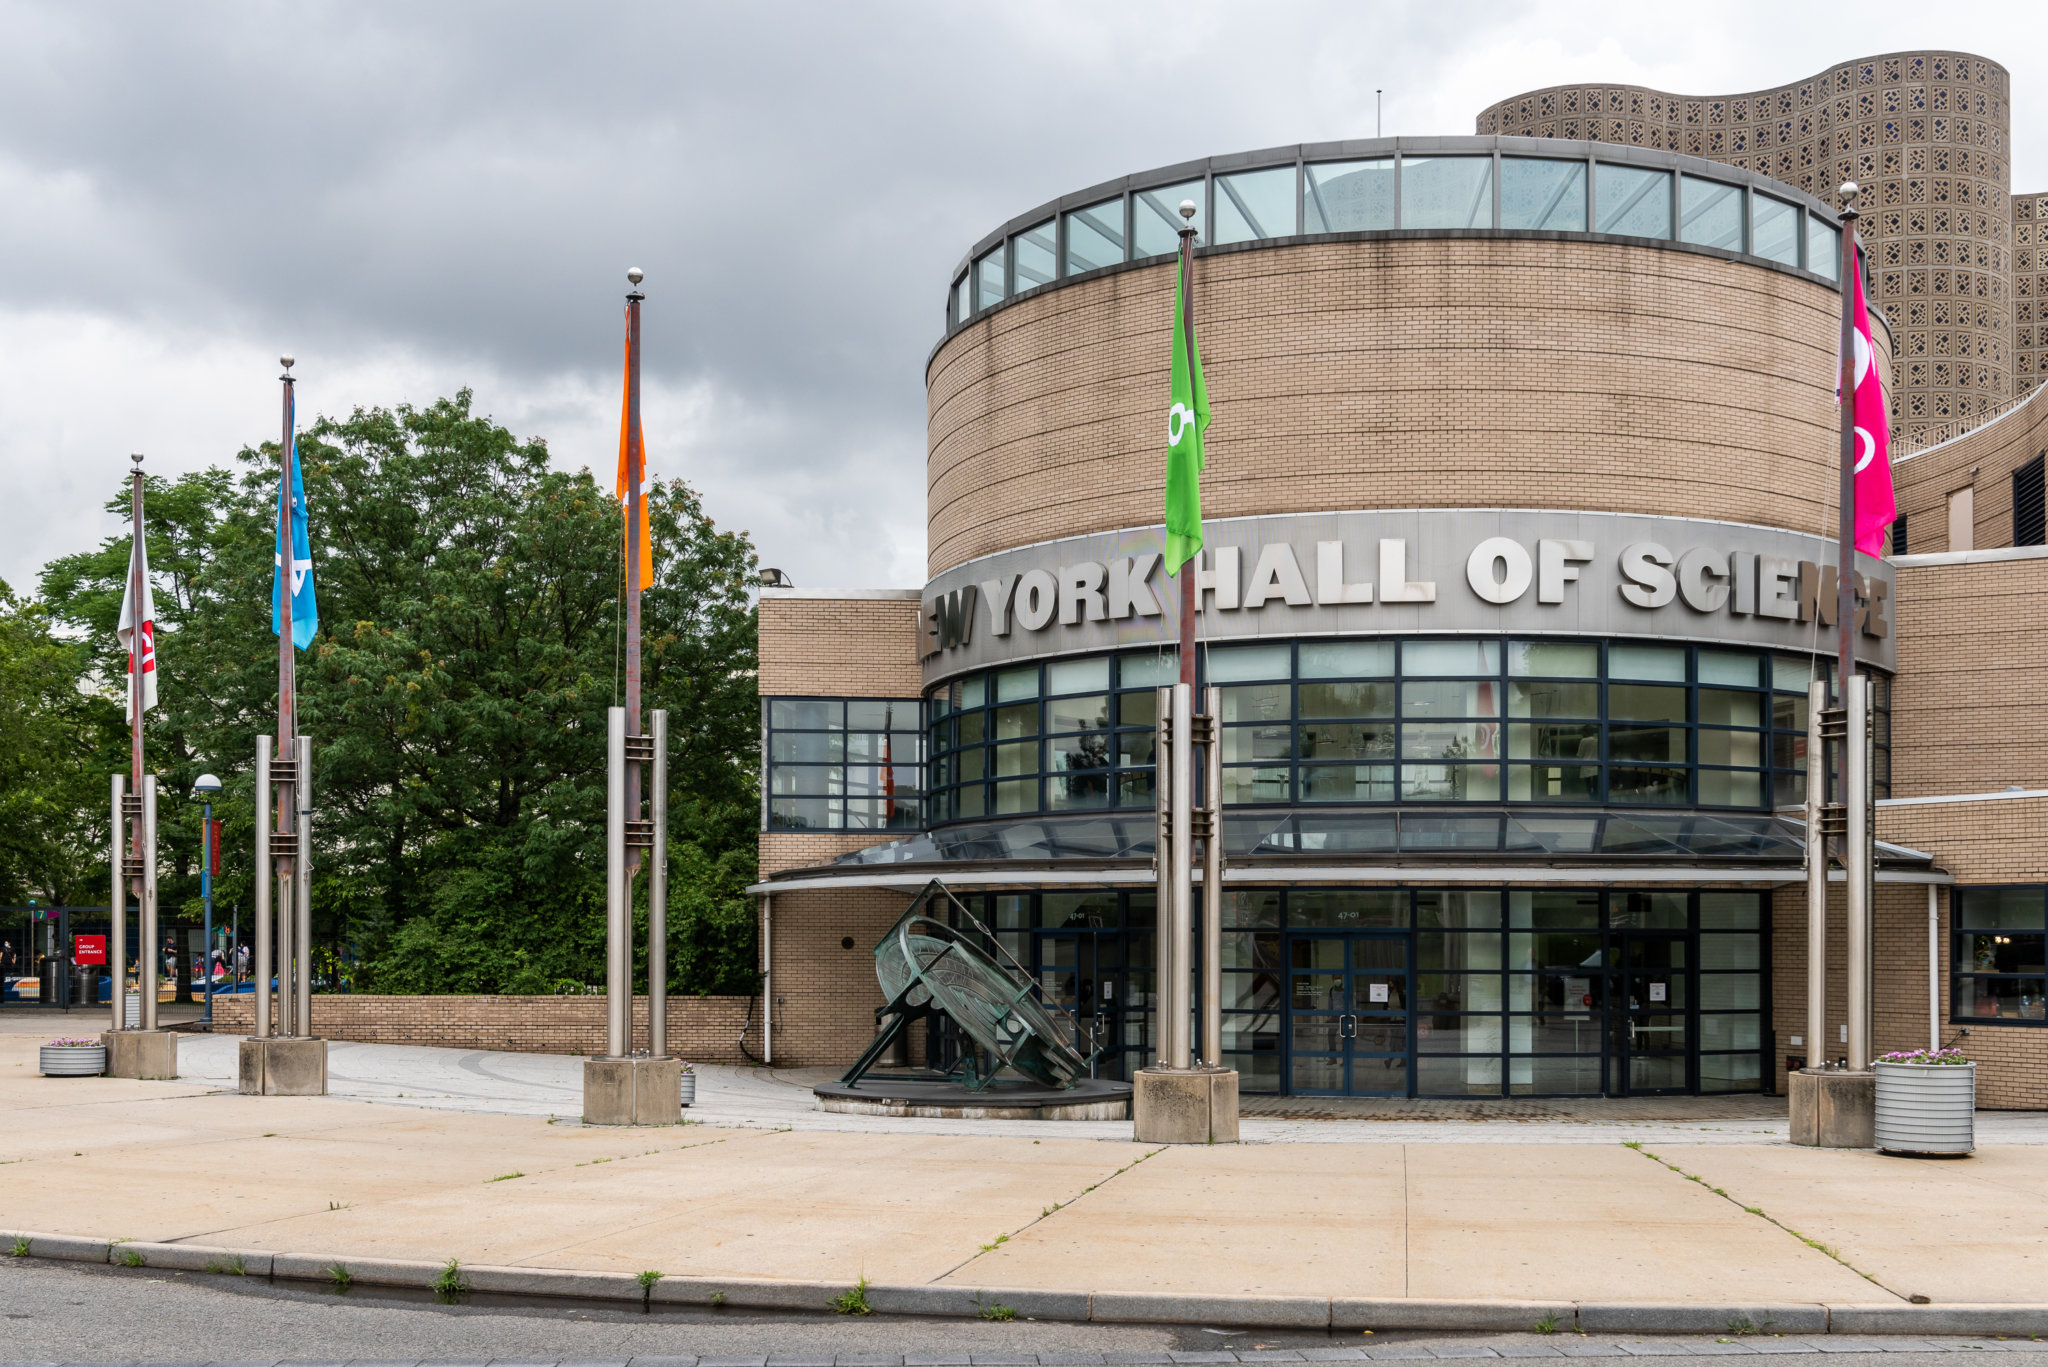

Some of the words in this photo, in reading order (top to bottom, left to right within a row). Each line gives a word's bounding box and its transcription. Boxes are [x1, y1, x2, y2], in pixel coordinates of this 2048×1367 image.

[917, 584, 977, 661] EW
[981, 553, 1163, 637] YORK
[1195, 538, 1436, 610] HALL
[1466, 537, 1595, 606] OF
